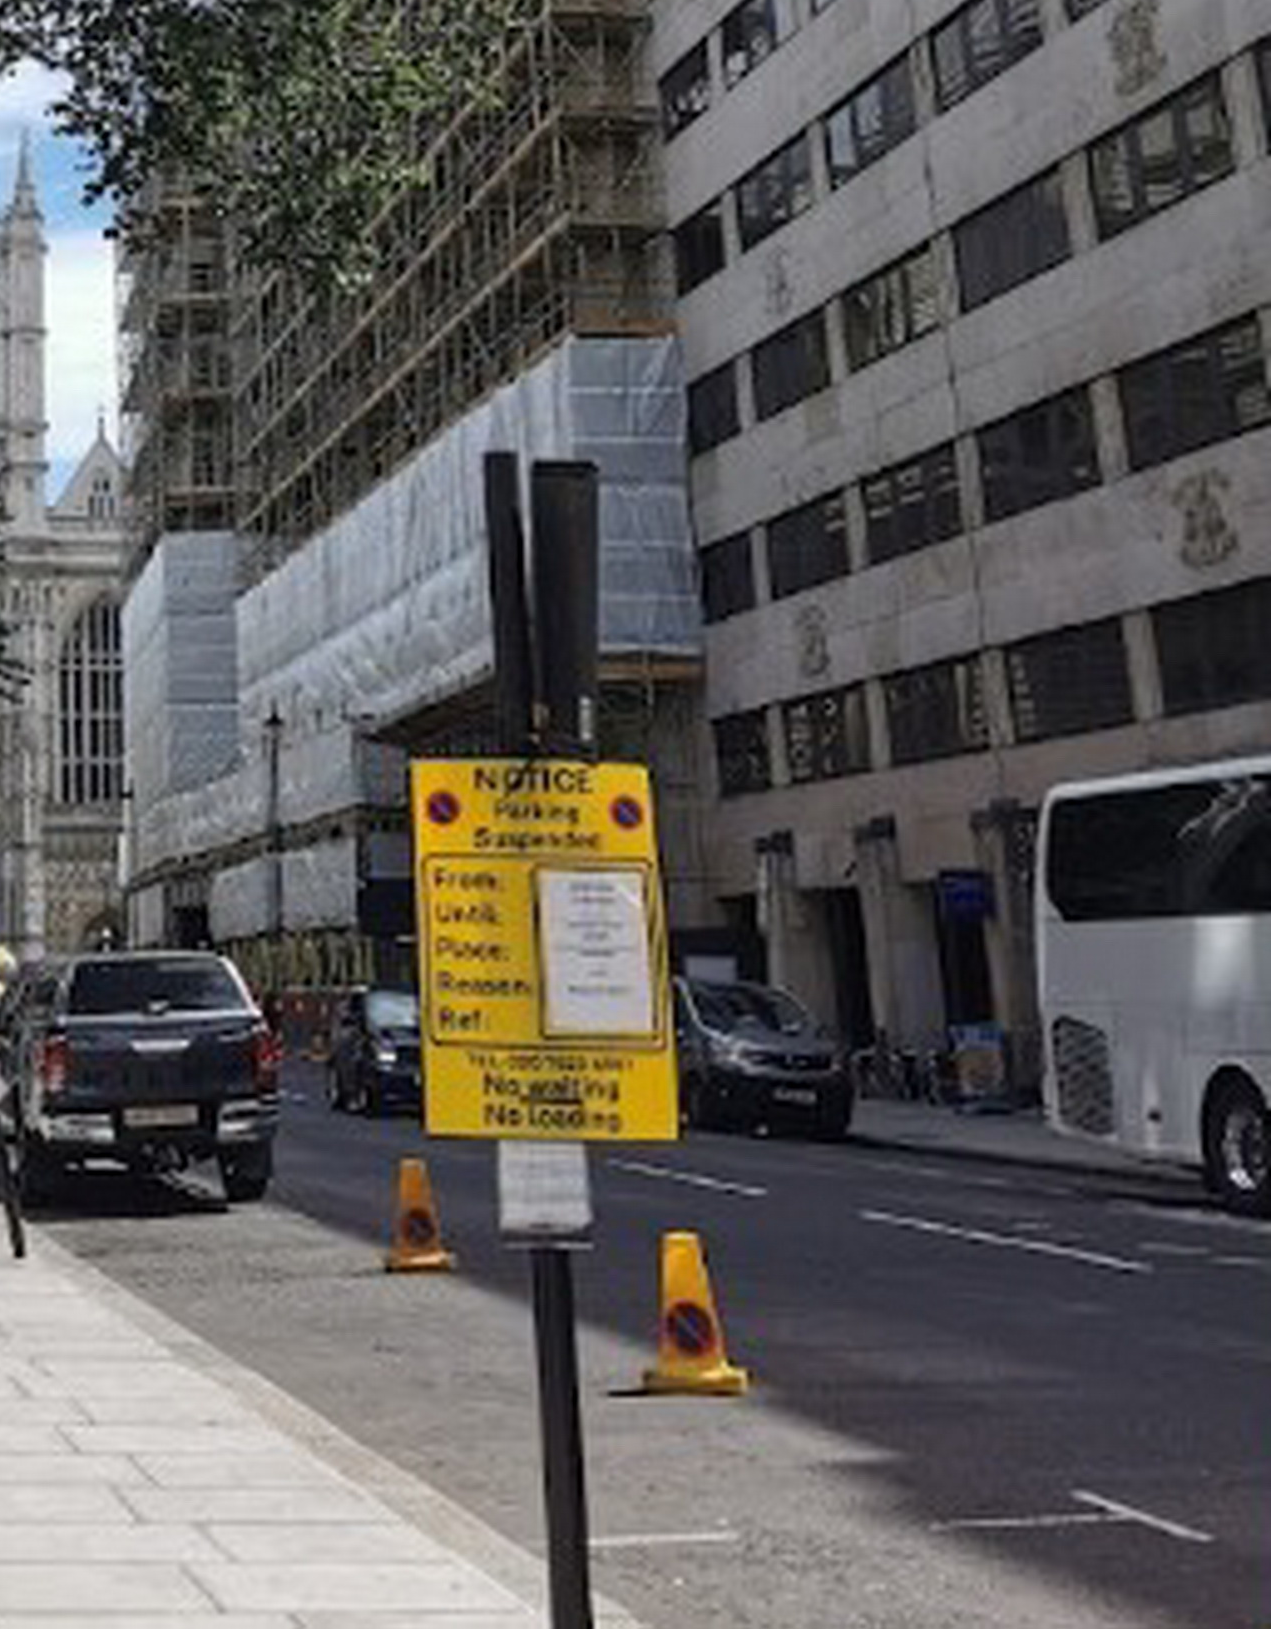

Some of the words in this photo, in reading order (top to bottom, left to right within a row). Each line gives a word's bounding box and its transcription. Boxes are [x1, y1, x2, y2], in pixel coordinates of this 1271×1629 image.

[473, 766, 595, 794] NOTICE
[493, 799, 580, 825] Parking
[473, 826, 600, 852] Suspended
[483, 1072, 520, 1097] No
[527, 1074, 620, 1103] waiting
[483, 1103, 523, 1126] No
[528, 1104, 623, 1133] loading
